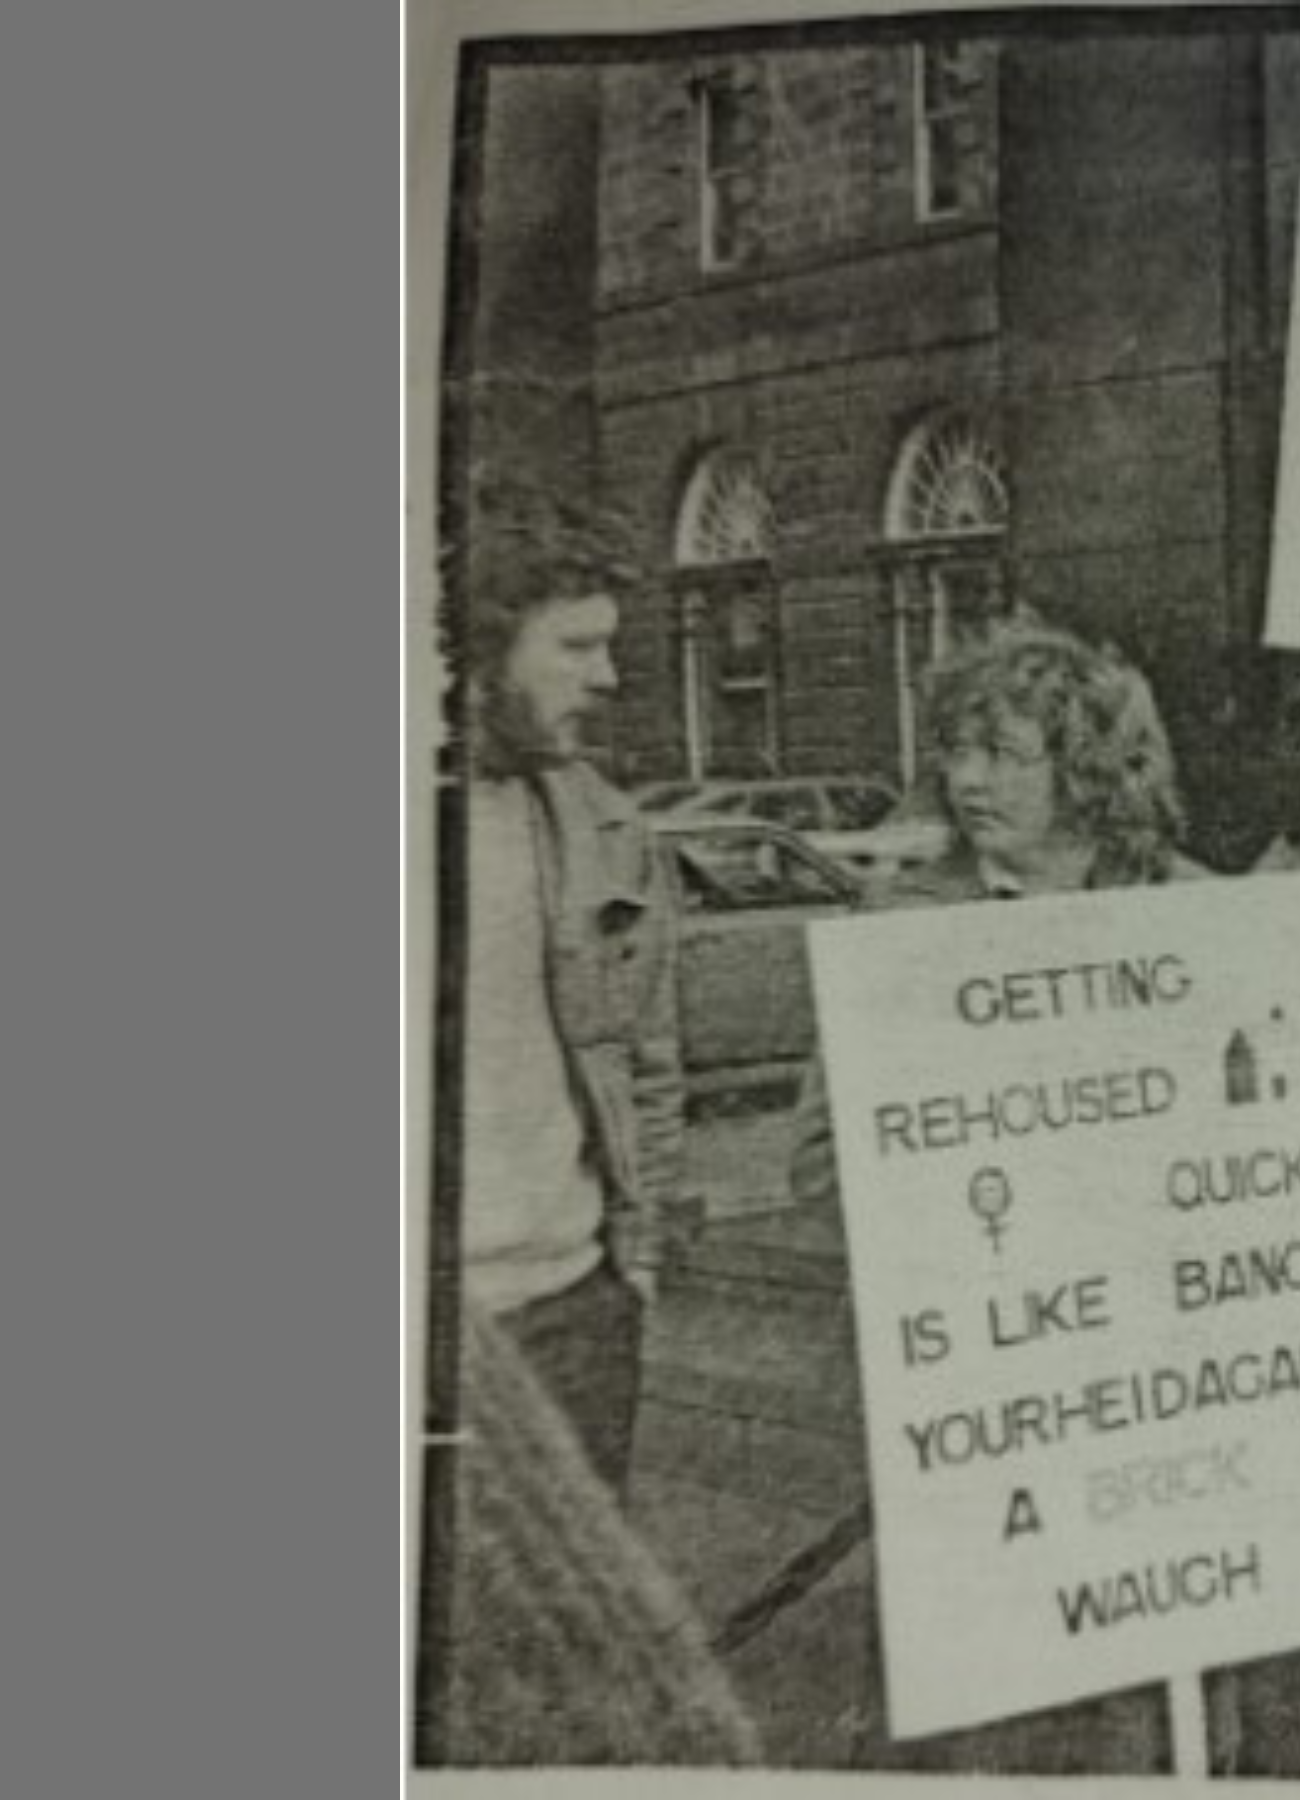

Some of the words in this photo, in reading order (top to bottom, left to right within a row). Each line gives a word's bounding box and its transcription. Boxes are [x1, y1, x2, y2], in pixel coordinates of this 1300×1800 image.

[955, 953, 1193, 1026] GETTING
[873, 1066, 1178, 1156] REHOUSED
[899, 1309, 952, 1367] IS
[987, 1276, 1111, 1348] LIKE
[1002, 1487, 1042, 1542] A
[1084, 1438, 1254, 1524] BRICK
[1056, 1541, 1262, 1637] WAUGH
